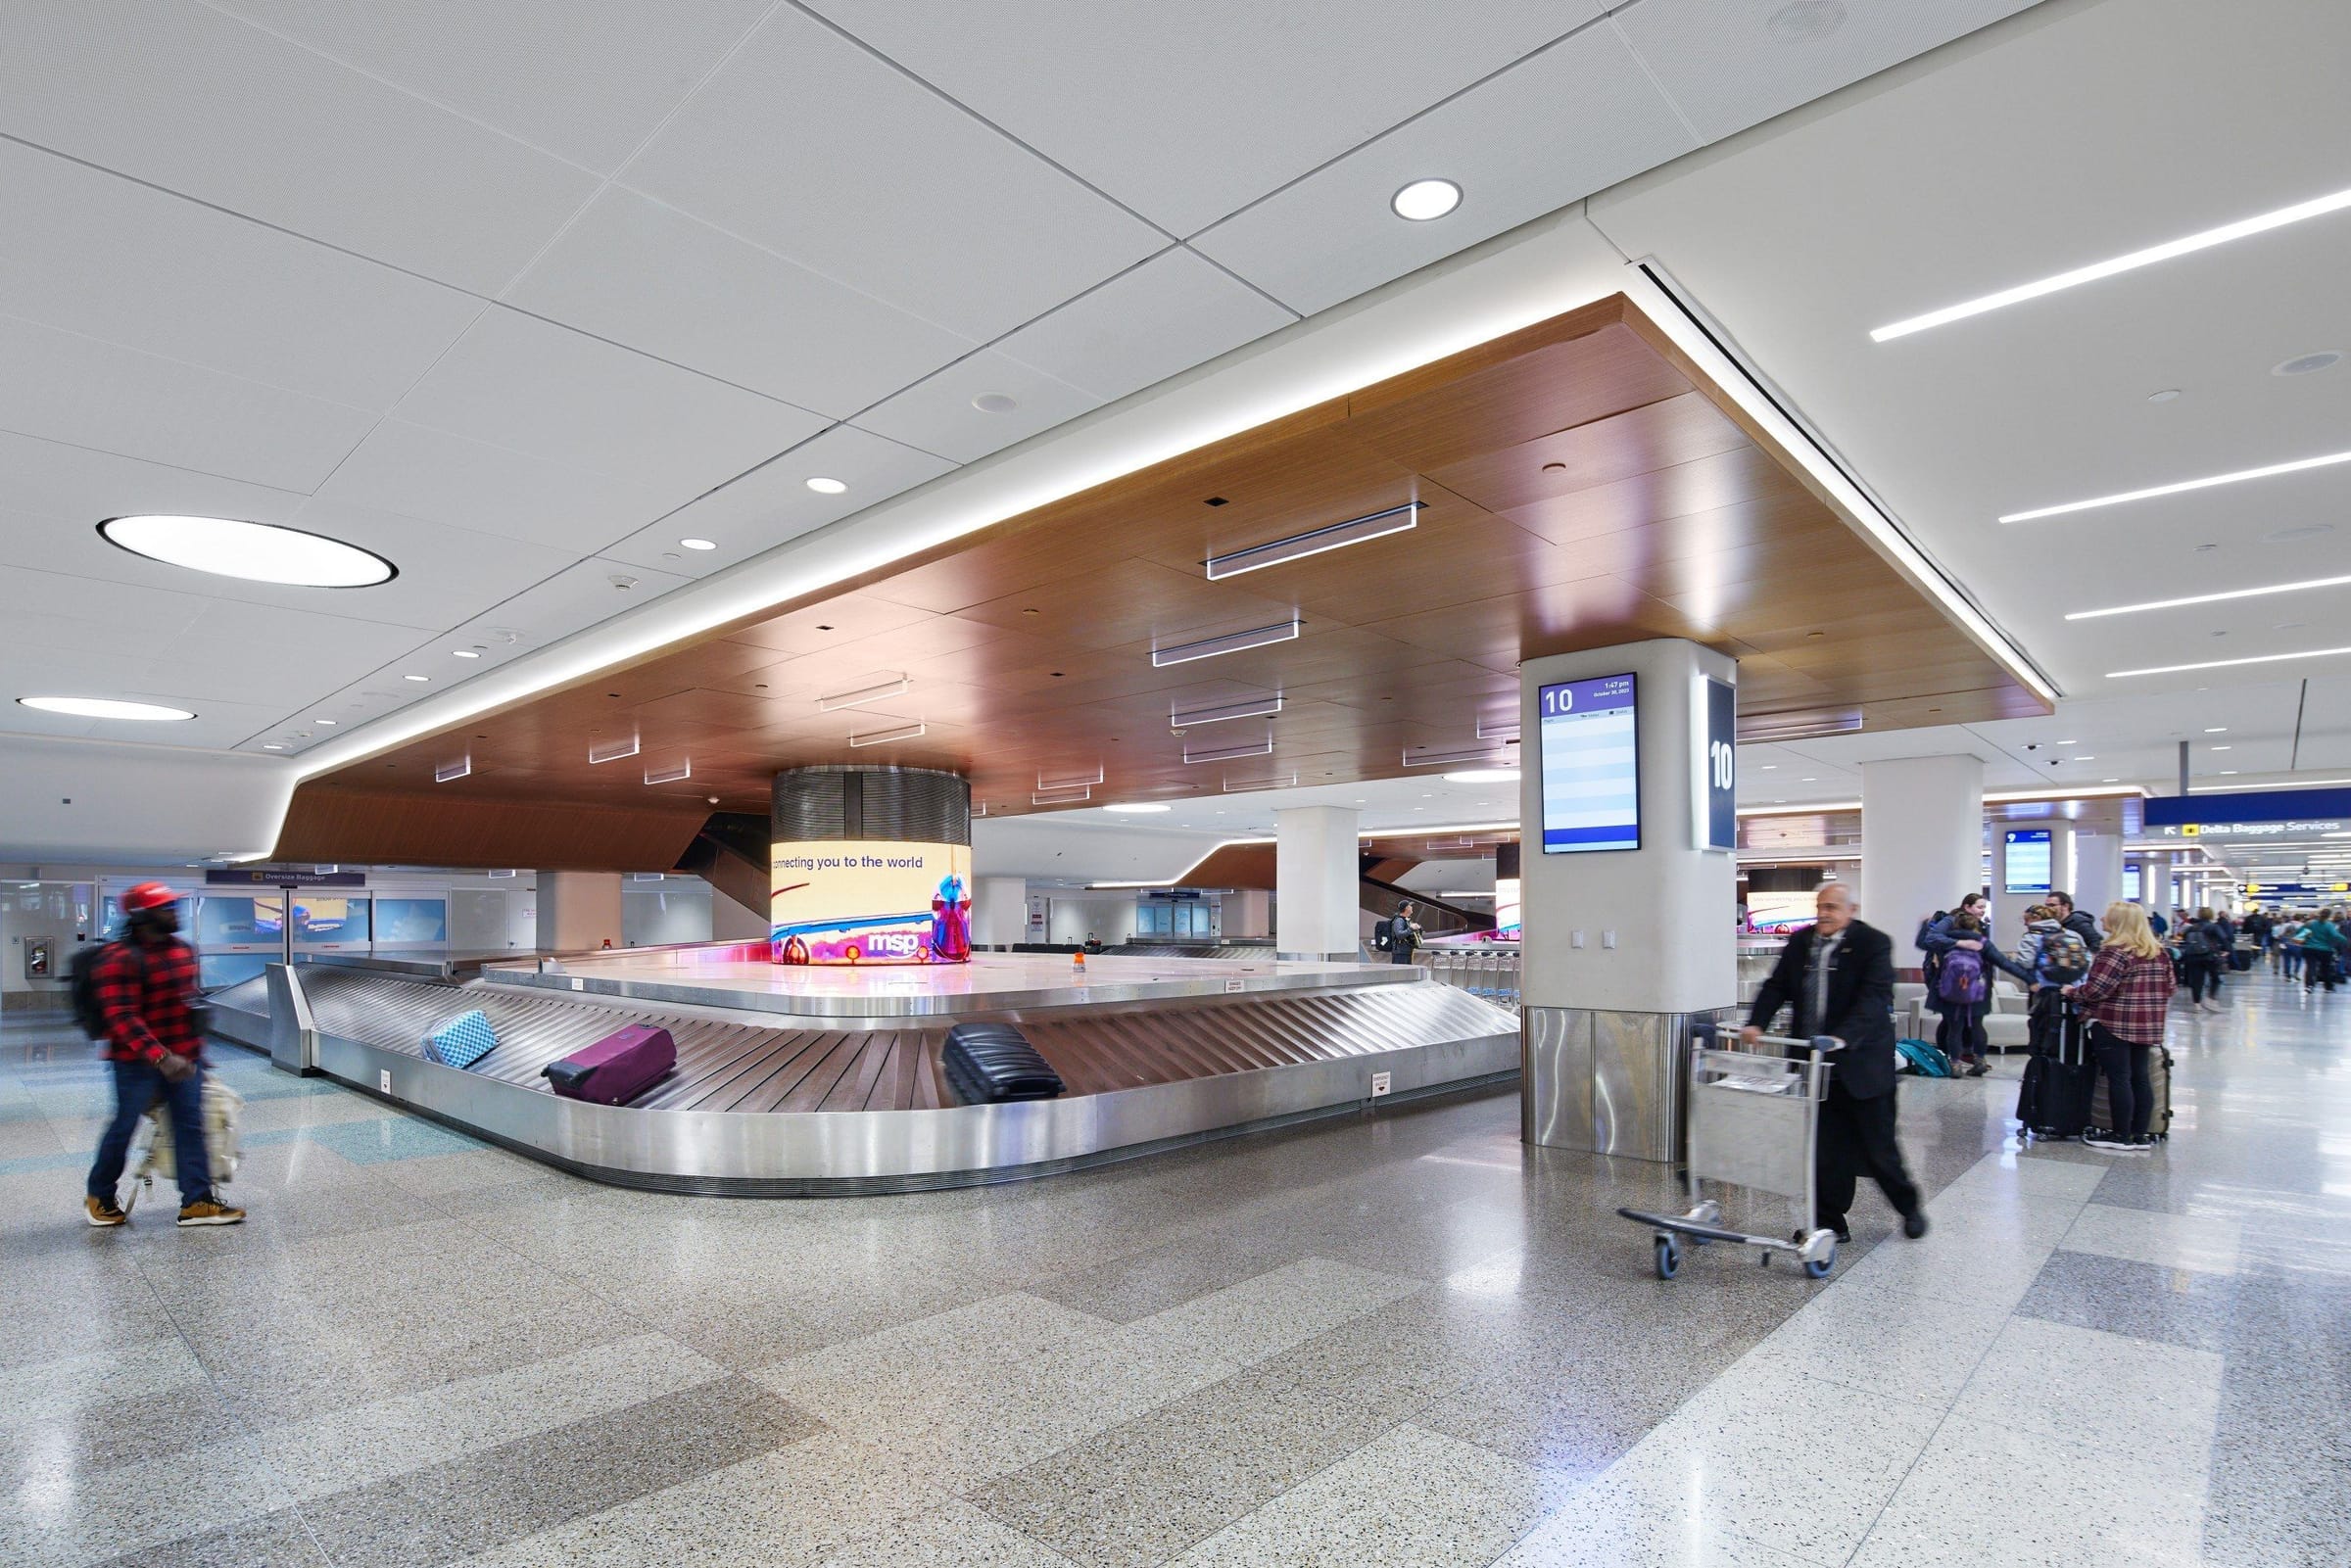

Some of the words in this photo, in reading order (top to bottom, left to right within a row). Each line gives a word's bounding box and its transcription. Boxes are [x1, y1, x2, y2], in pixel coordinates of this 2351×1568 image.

[1546, 689, 1572, 713] 10
[1710, 740, 1733, 790] 10
[2200, 825, 2231, 834] Delta
[2232, 824, 2285, 834] Baggage
[2286, 821, 2340, 832] Services
[2007, 833, 2016, 842] 9
[817, 858, 840, 871] you
[844, 856, 857, 868] to
[861, 856, 883, 868] the
[888, 857, 923, 869] world
[868, 934, 919, 954] msp
